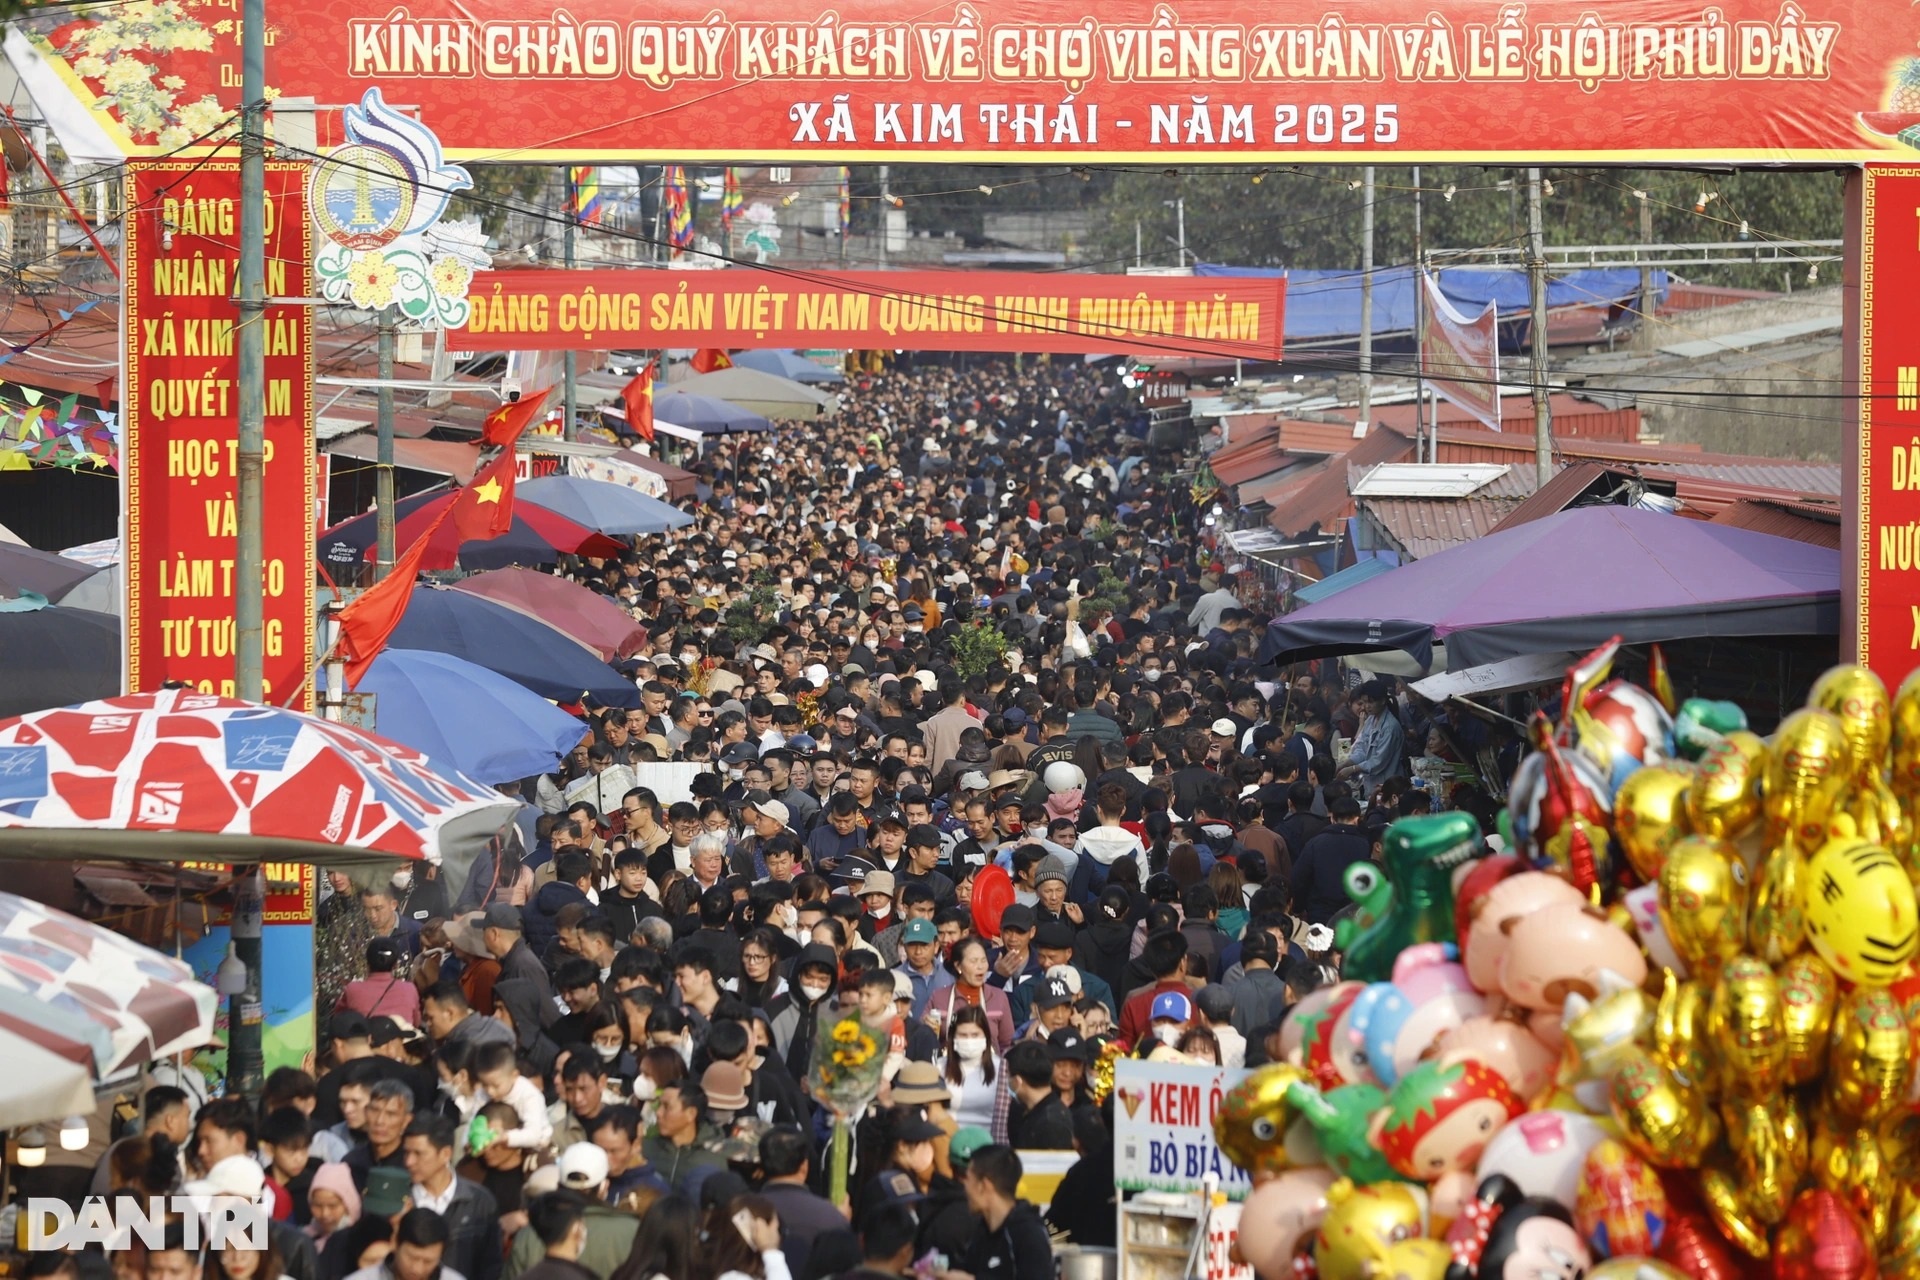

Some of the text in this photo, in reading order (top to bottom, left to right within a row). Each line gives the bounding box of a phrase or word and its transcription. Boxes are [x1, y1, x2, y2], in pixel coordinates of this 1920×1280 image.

[352, 3, 1838, 91] KÍNH CHÀO QUÝ KHÁCH VỀ CHỢ VIỀNG XUÂN VÀ LỄ HỘI PHỦ DẦY
[789, 94, 857, 143] XÃ
[874, 103, 964, 143] KIM
[979, 95, 1098, 143] THÁI
[1150, 94, 1255, 143] NĂM
[1274, 104, 1398, 143] 2025
[163, 185, 234, 236] ĐẢNG
[154, 251, 226, 296] NHÂN
[143, 311, 177, 356] XÃ
[184, 319, 233, 356] KIM
[468, 280, 1261, 344] ĐẢNG CỘNG SẢN VIỆT NAM QUANG VINH MUÔN NĂM
[151, 367, 230, 421] QUYẾT
[1147, 382, 1186, 400] VỆ SINH
[168, 439, 275, 486] HỌC TP
[205, 491, 238, 537] VÀ
[160, 552, 213, 597] LÀM
[160, 615, 194, 658] TƯ
[1150, 1072, 1225, 1128] KEM Ố
[1149, 1132, 1178, 1176] BÒ
[1185, 1134, 1224, 1181] BÍA
